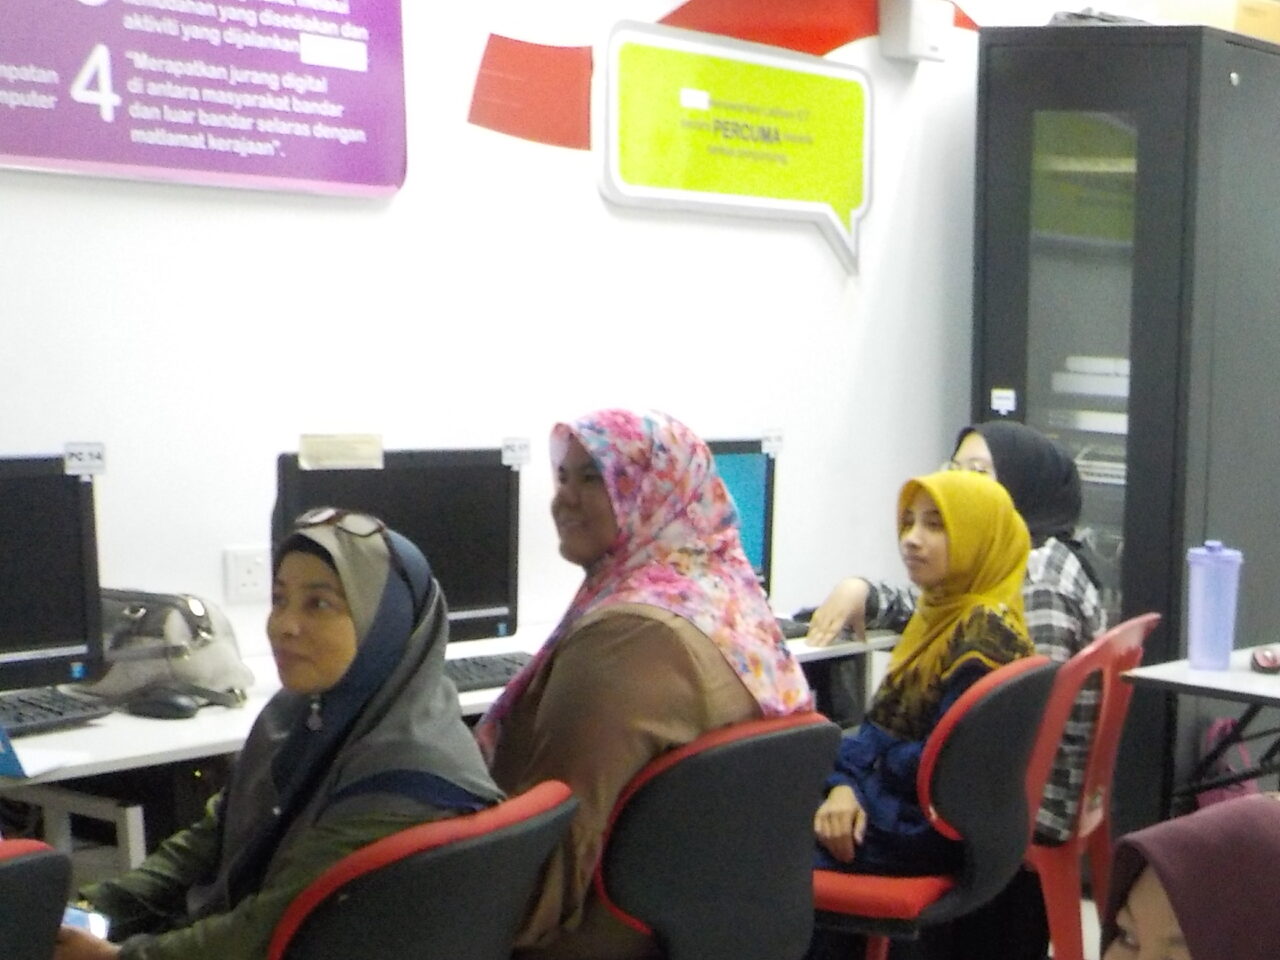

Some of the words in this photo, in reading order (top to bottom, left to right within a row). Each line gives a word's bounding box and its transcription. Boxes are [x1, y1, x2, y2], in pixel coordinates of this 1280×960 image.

[218, 6, 258, 28] yang
[70, 43, 122, 122] 4
[712, 118, 782, 146] PERCUMA
